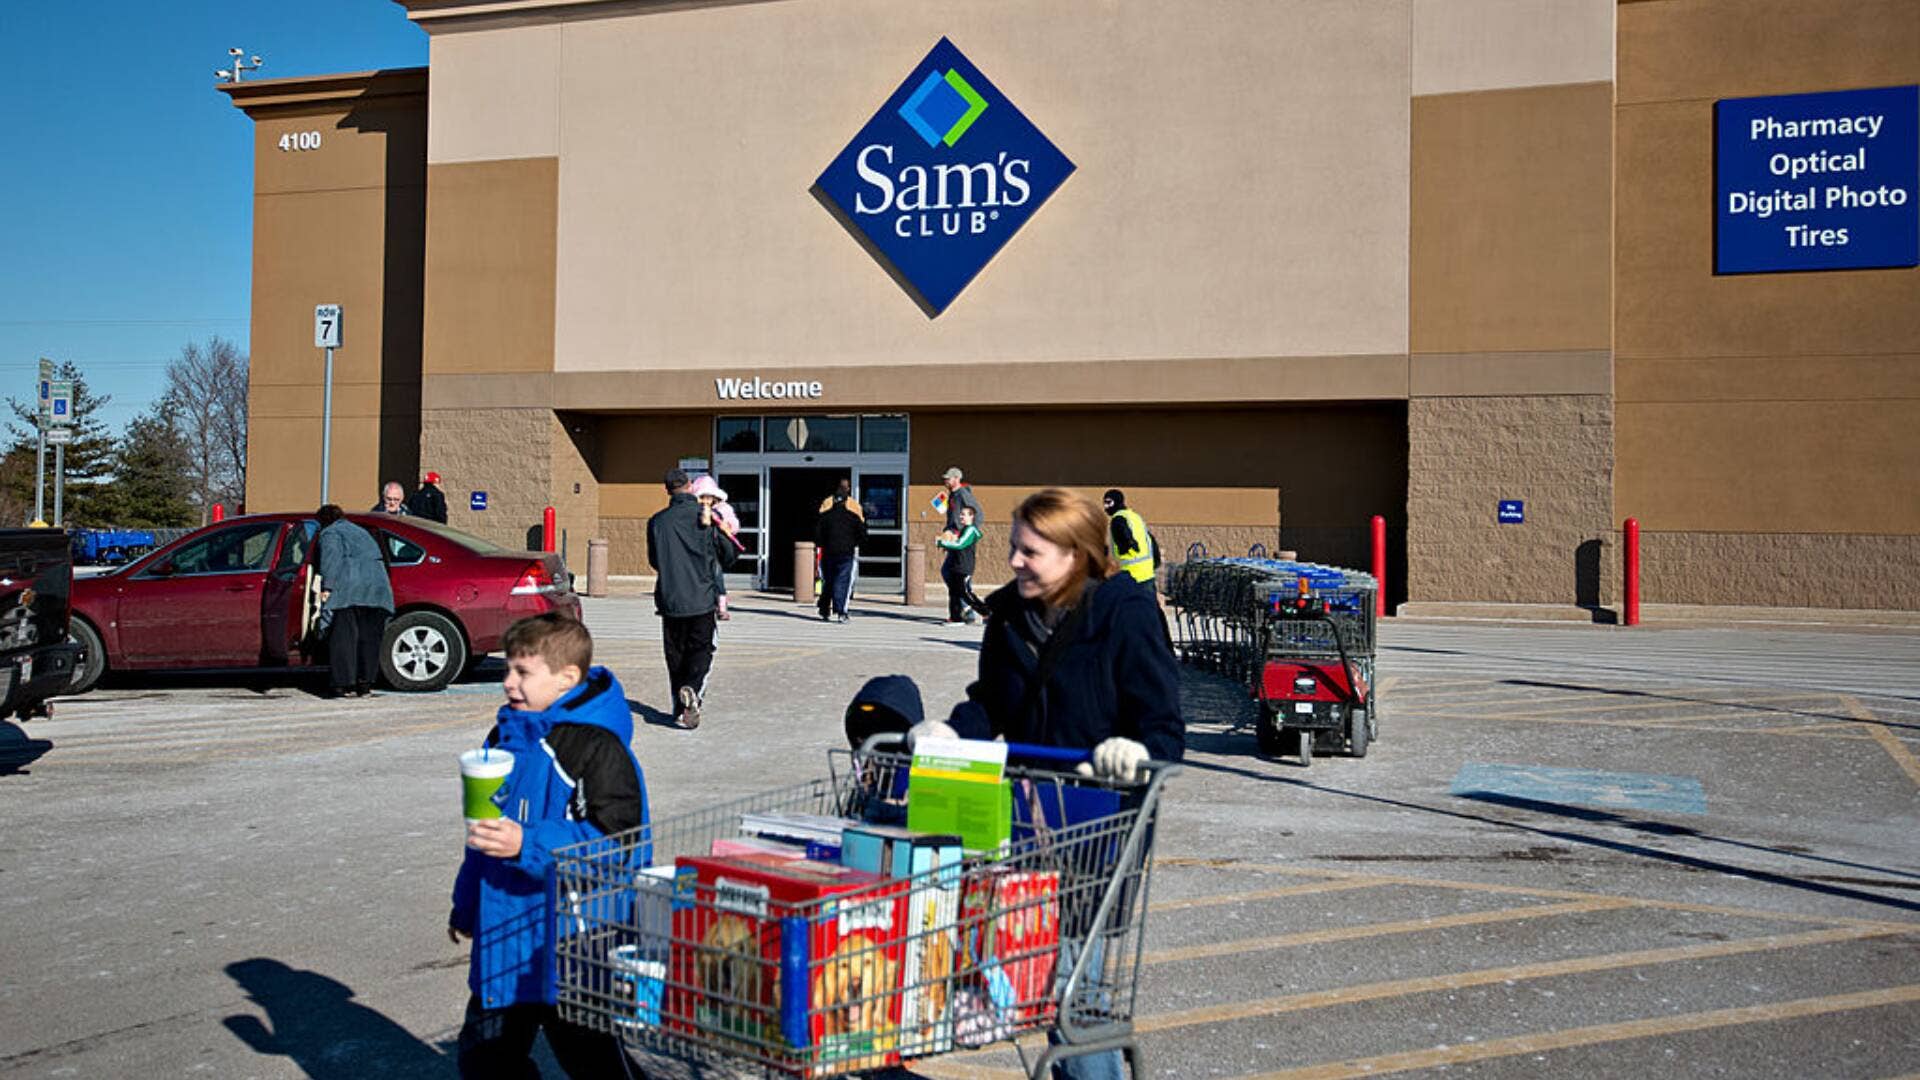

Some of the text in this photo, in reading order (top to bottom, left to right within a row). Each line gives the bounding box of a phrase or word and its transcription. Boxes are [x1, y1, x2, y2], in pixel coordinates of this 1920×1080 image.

[1751, 115, 1884, 140] Pharmacy
[278, 131, 322, 151] 4100
[1769, 147, 1865, 180] Optical
[855, 143, 1031, 214] Sam's
[1729, 185, 1908, 218] Digital Photo
[1785, 224, 1849, 247] Tires
[321, 320, 332, 340] 7
[715, 376, 823, 399] Welcome
